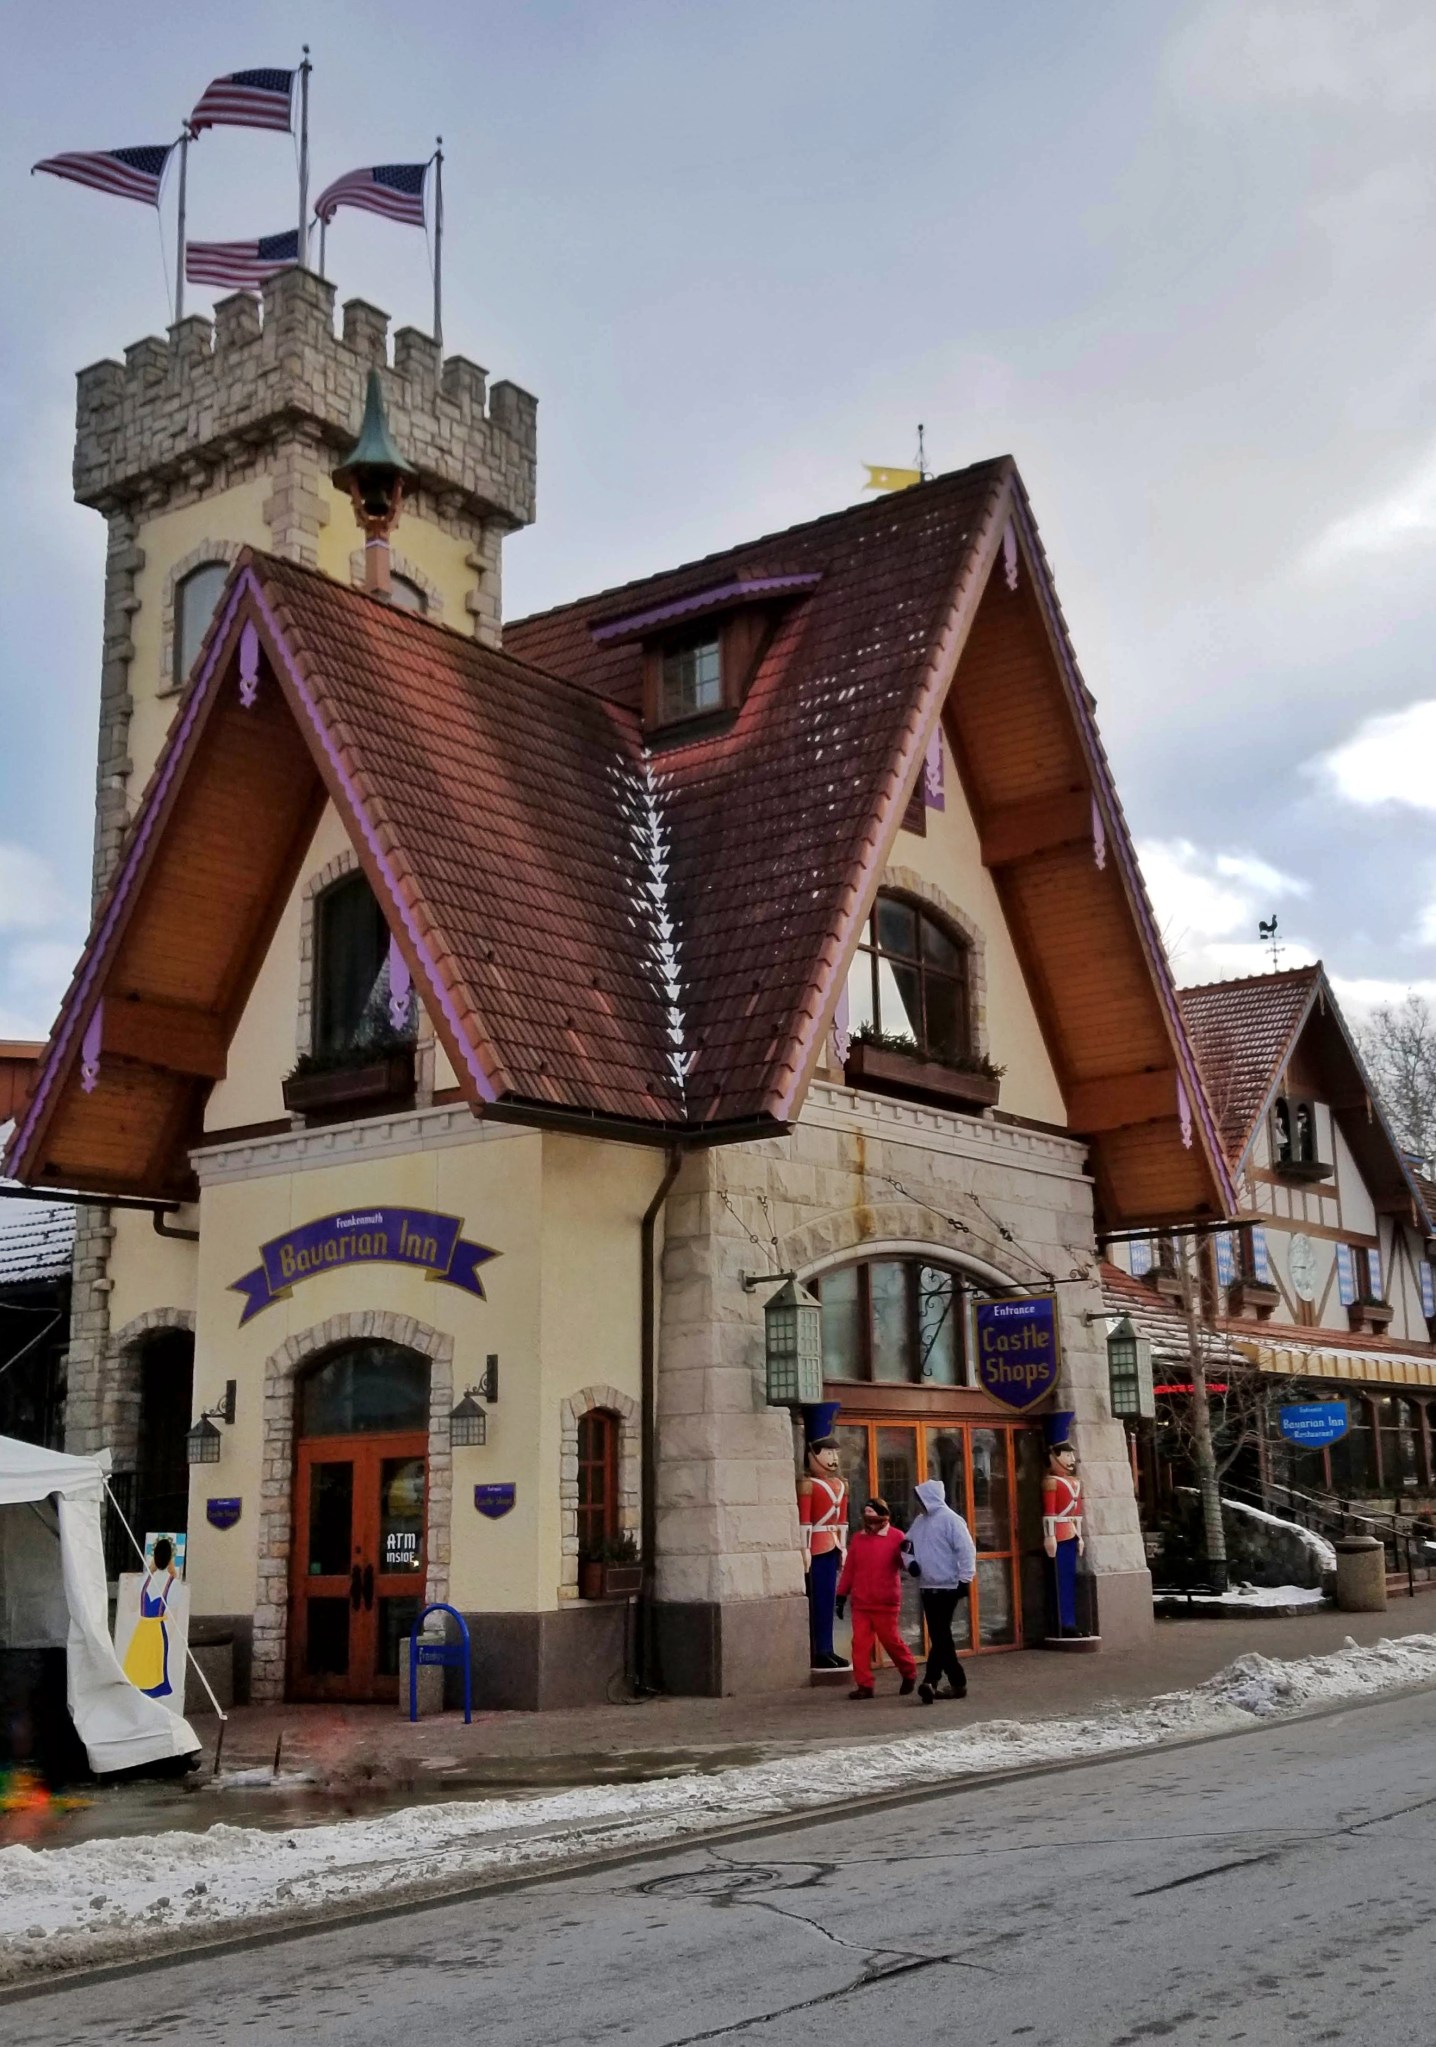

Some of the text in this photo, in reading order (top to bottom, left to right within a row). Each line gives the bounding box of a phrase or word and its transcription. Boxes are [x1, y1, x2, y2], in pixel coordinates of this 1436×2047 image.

[336, 1211, 383, 1229] Frankenmuth
[279, 1219, 438, 1278] Bavarian Inn
[993, 1305, 1035, 1317] Entrance
[982, 1323, 1049, 1353] Castle
[985, 1357, 1050, 1390] Shops
[1283, 1416, 1344, 1429] Bavarian Inn
[1294, 1430, 1334, 1438] Restaurant
[387, 1532, 416, 1550] ATM
[386, 1552, 415, 1563] INSIDE
